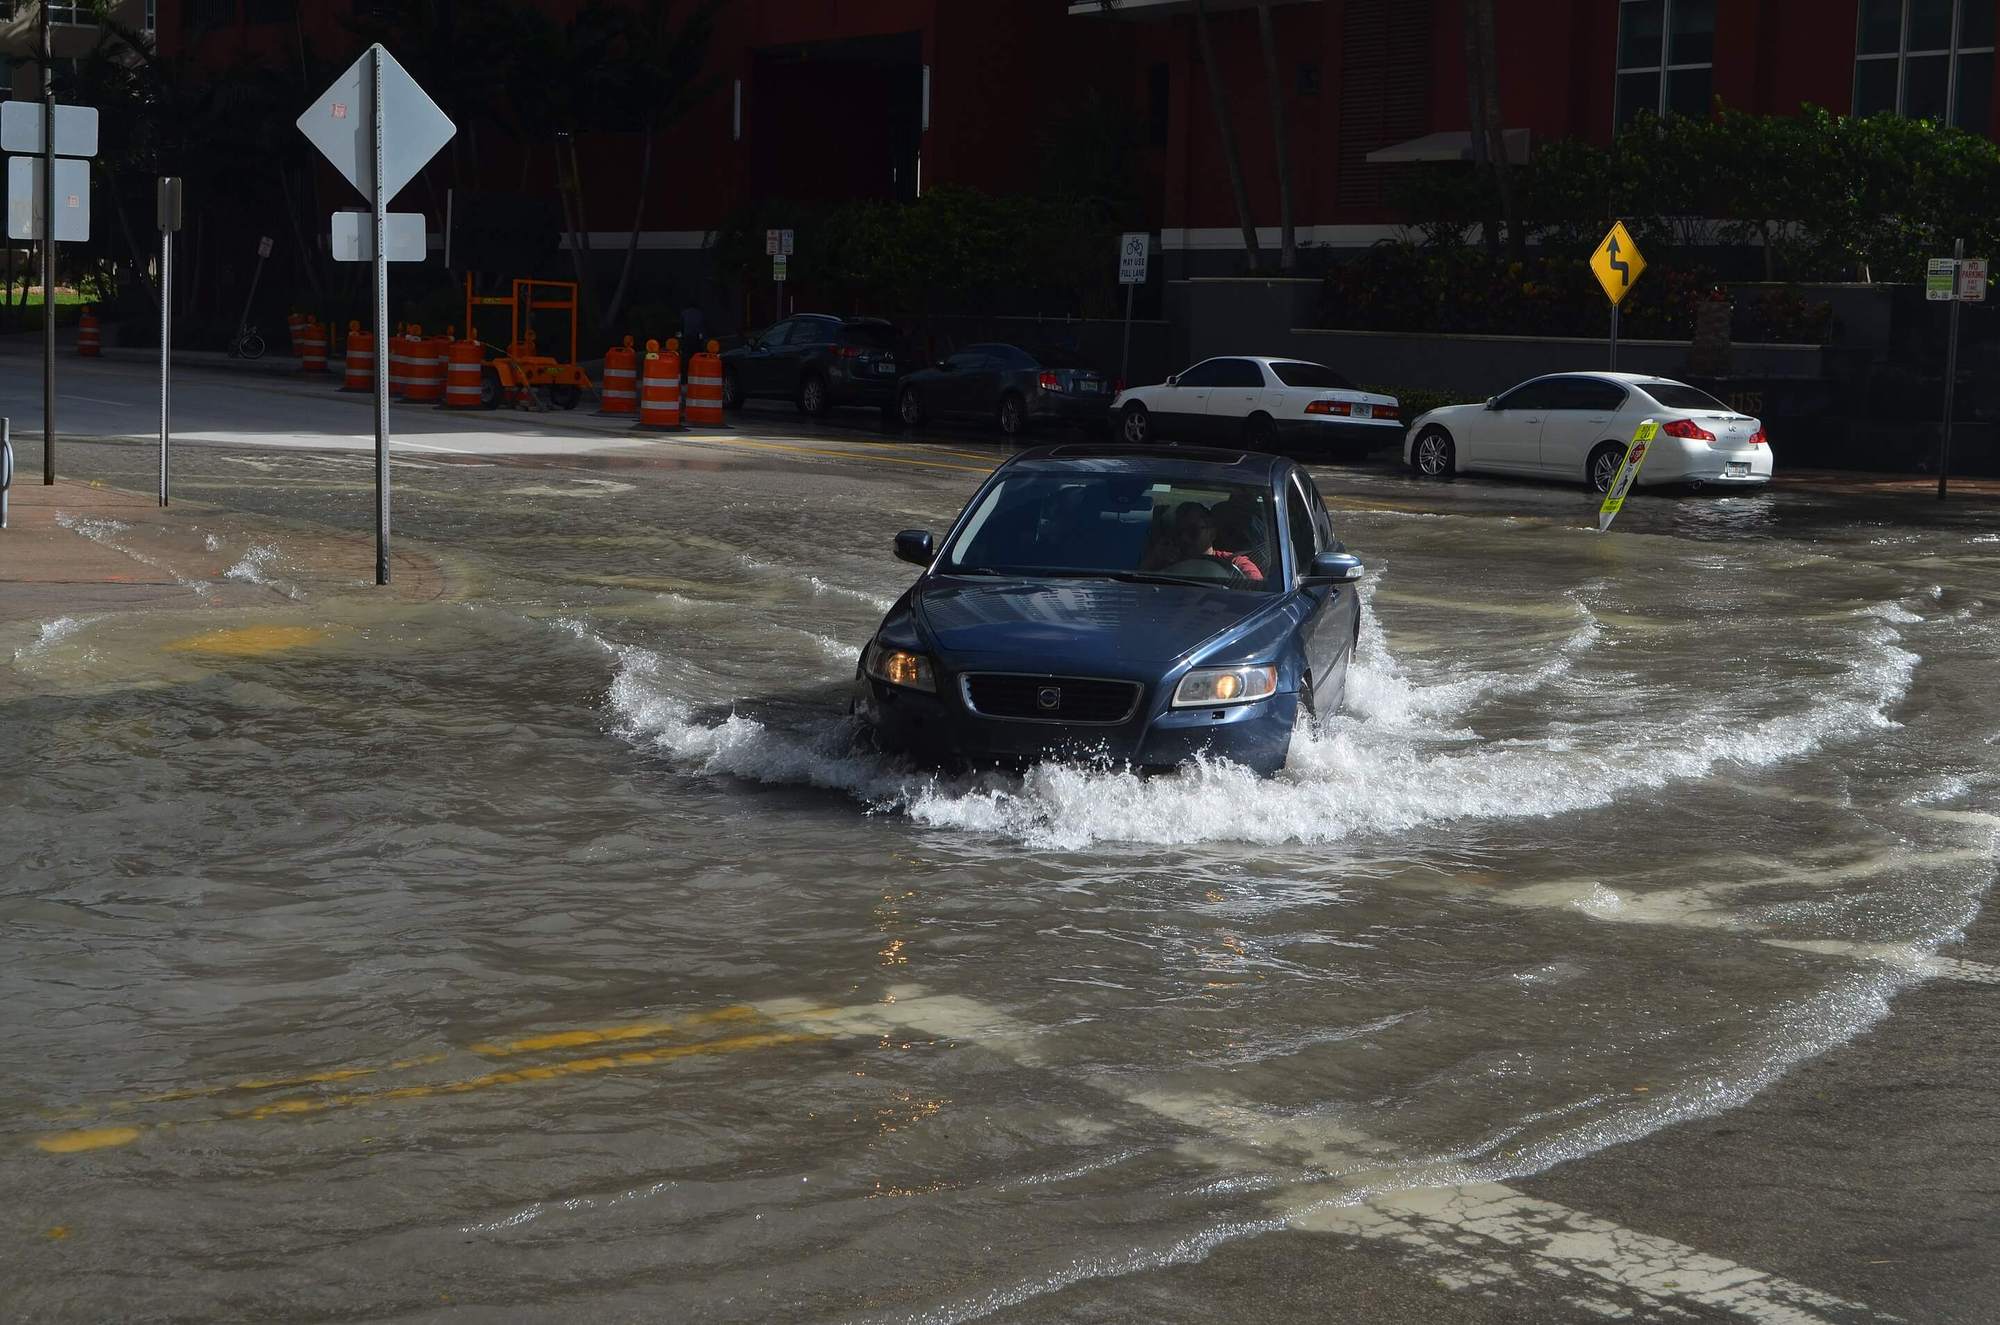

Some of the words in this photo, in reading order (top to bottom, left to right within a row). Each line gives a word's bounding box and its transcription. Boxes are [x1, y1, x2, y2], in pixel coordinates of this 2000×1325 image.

[1123, 258, 1133, 266] MAY
[1134, 258, 1144, 266] USE
[1968, 262, 1978, 270] NO
[1121, 269, 1131, 277] FULL
[1133, 268, 1144, 277] LANE
